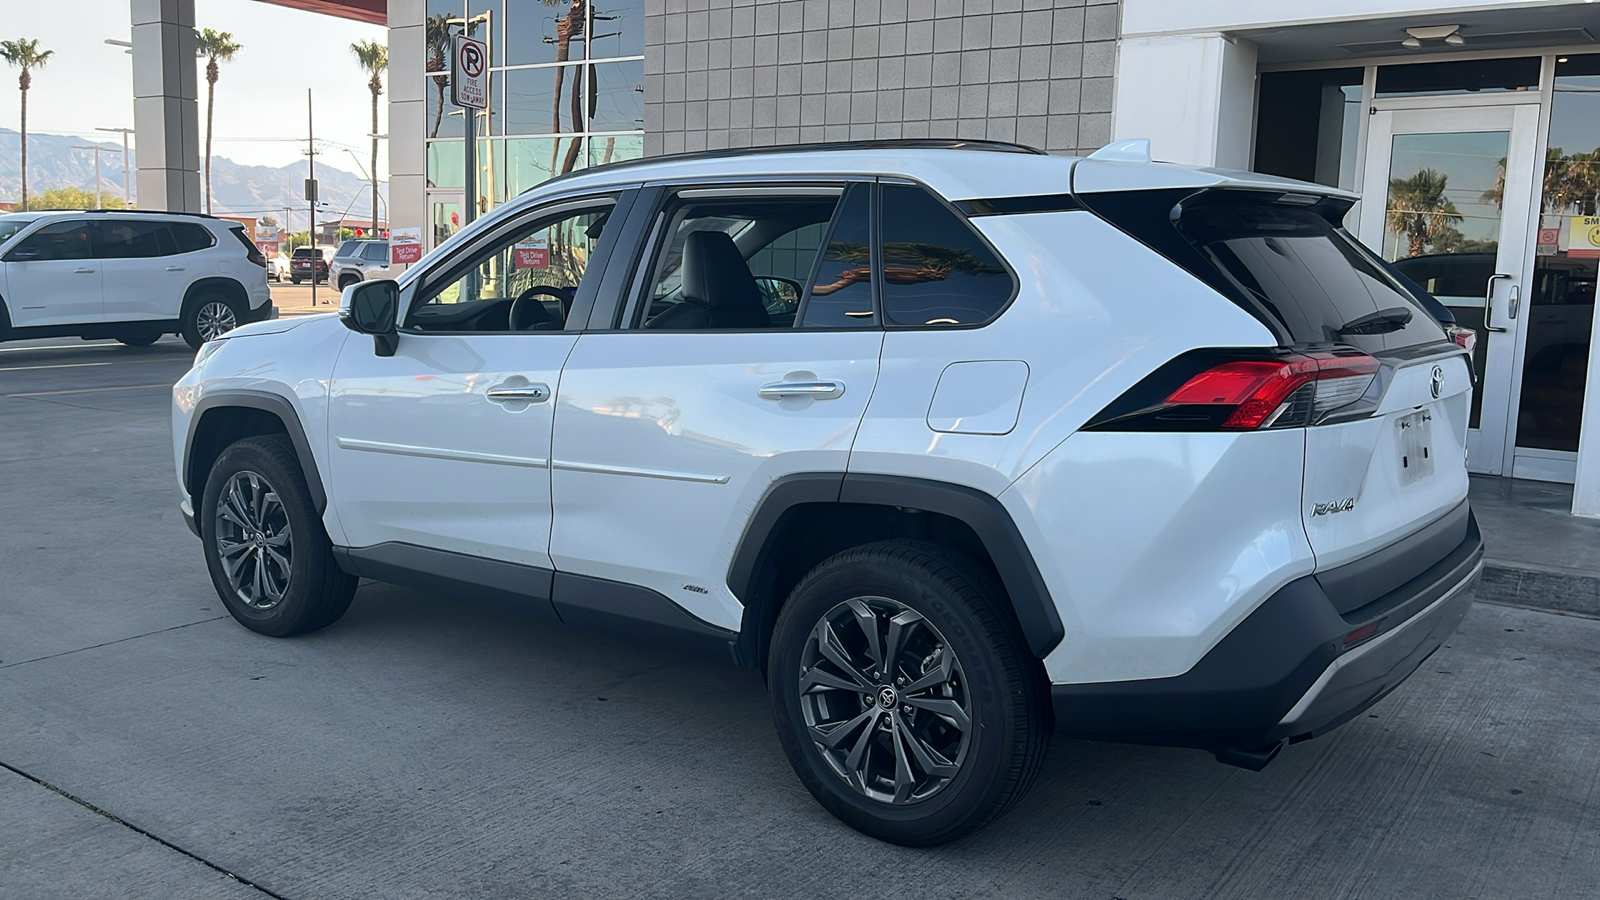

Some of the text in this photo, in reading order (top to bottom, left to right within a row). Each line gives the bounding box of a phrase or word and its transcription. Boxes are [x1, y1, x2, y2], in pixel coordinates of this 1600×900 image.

[467, 78, 477, 87] FIRE
[463, 85, 482, 96] ACCESS
[461, 92, 484, 104] TOW-AWAY
[396, 246, 418, 255] Test Drive
[519, 250, 544, 259] Test Drive
[1310, 497, 1354, 517] RAV4
[921, 588, 994, 703] YOKOHAMA
